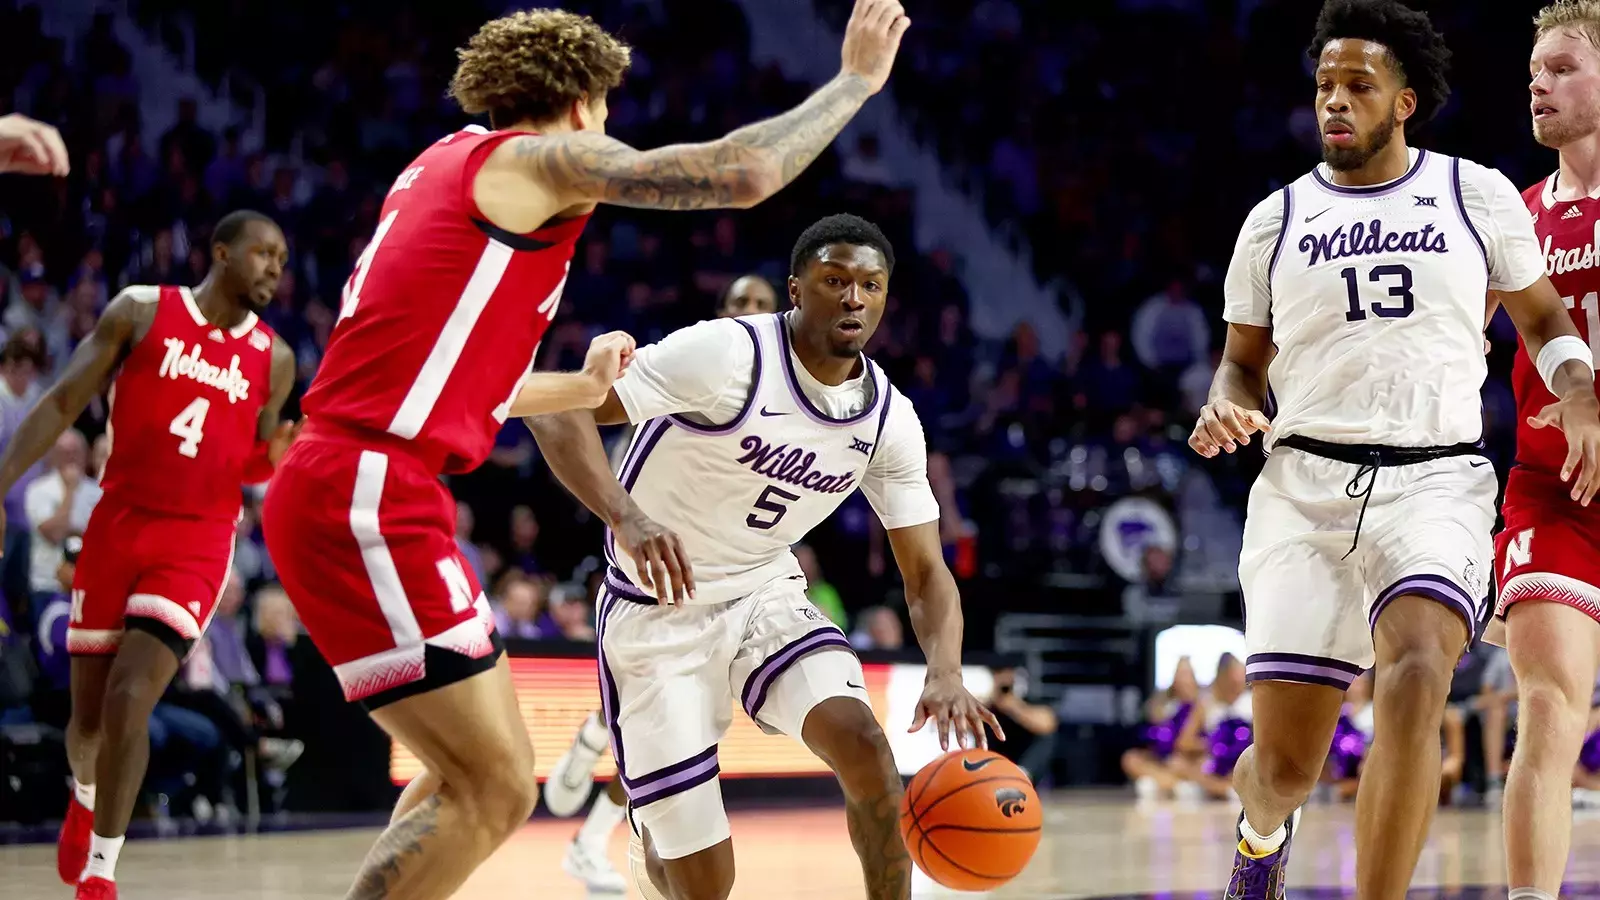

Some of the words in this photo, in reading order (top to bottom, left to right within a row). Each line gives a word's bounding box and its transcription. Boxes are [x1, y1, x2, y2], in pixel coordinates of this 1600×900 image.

[1298, 219, 1449, 268] Wildcats
[1340, 264, 1415, 322] 13
[158, 336, 251, 404] Nebraska
[168, 396, 211, 459] 4
[735, 435, 857, 494] Wildcats
[745, 484, 801, 530] 5
[1502, 527, 1535, 579] N
